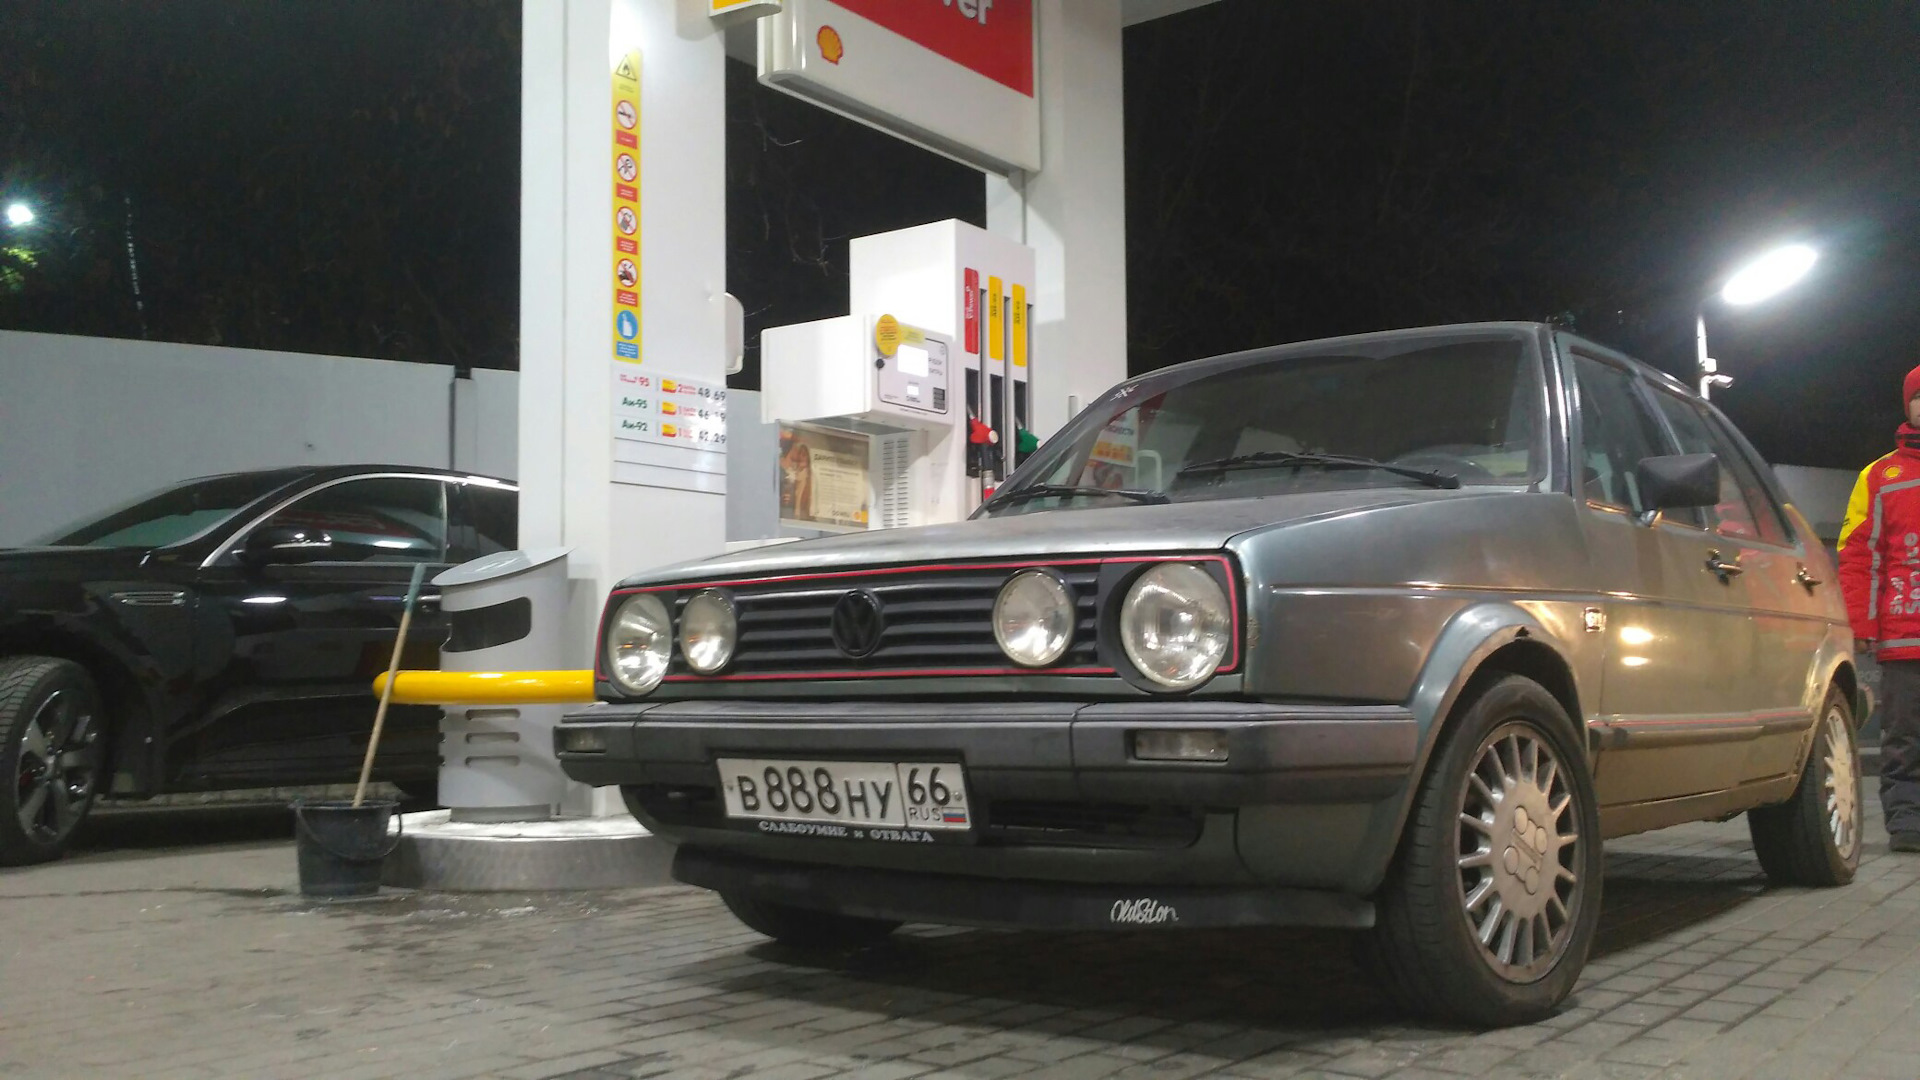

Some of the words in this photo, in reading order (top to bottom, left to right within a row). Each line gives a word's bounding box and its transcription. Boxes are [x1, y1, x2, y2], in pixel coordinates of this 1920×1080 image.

[907, 767, 951, 806] 66
[909, 808, 941, 822] RUS
[870, 829, 935, 842] ОТВАГА
